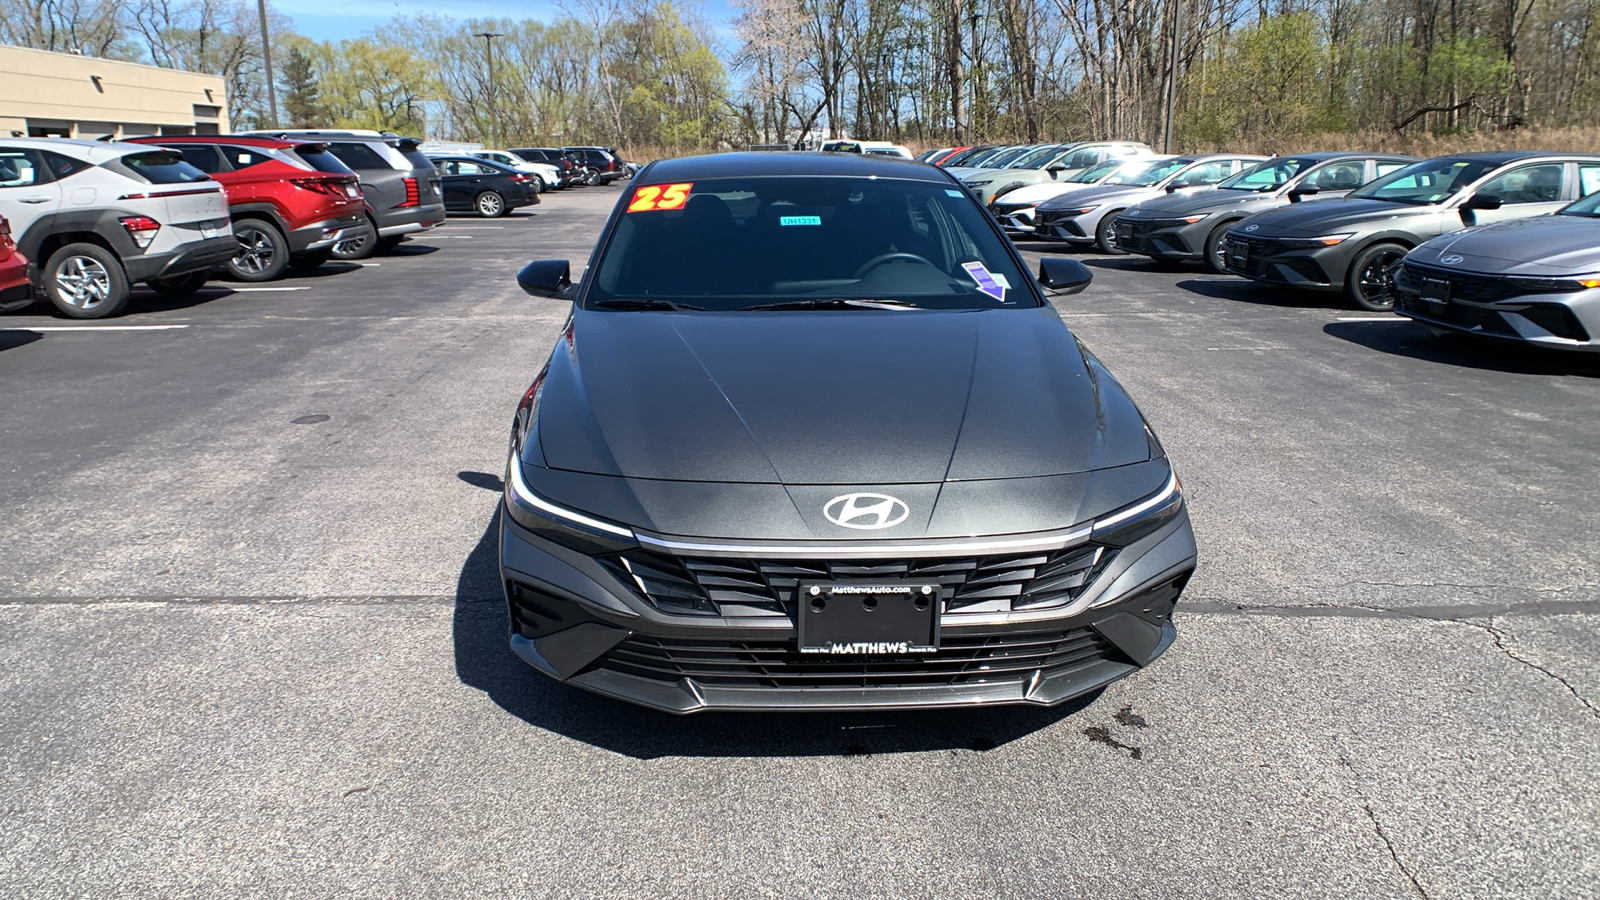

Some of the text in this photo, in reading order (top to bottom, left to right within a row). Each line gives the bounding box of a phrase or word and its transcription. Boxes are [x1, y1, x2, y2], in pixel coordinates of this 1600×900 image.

[630, 184, 691, 210] 25
[831, 586, 911, 594] MatthewsAuto.com
[831, 642, 907, 654] MATTHEWS
